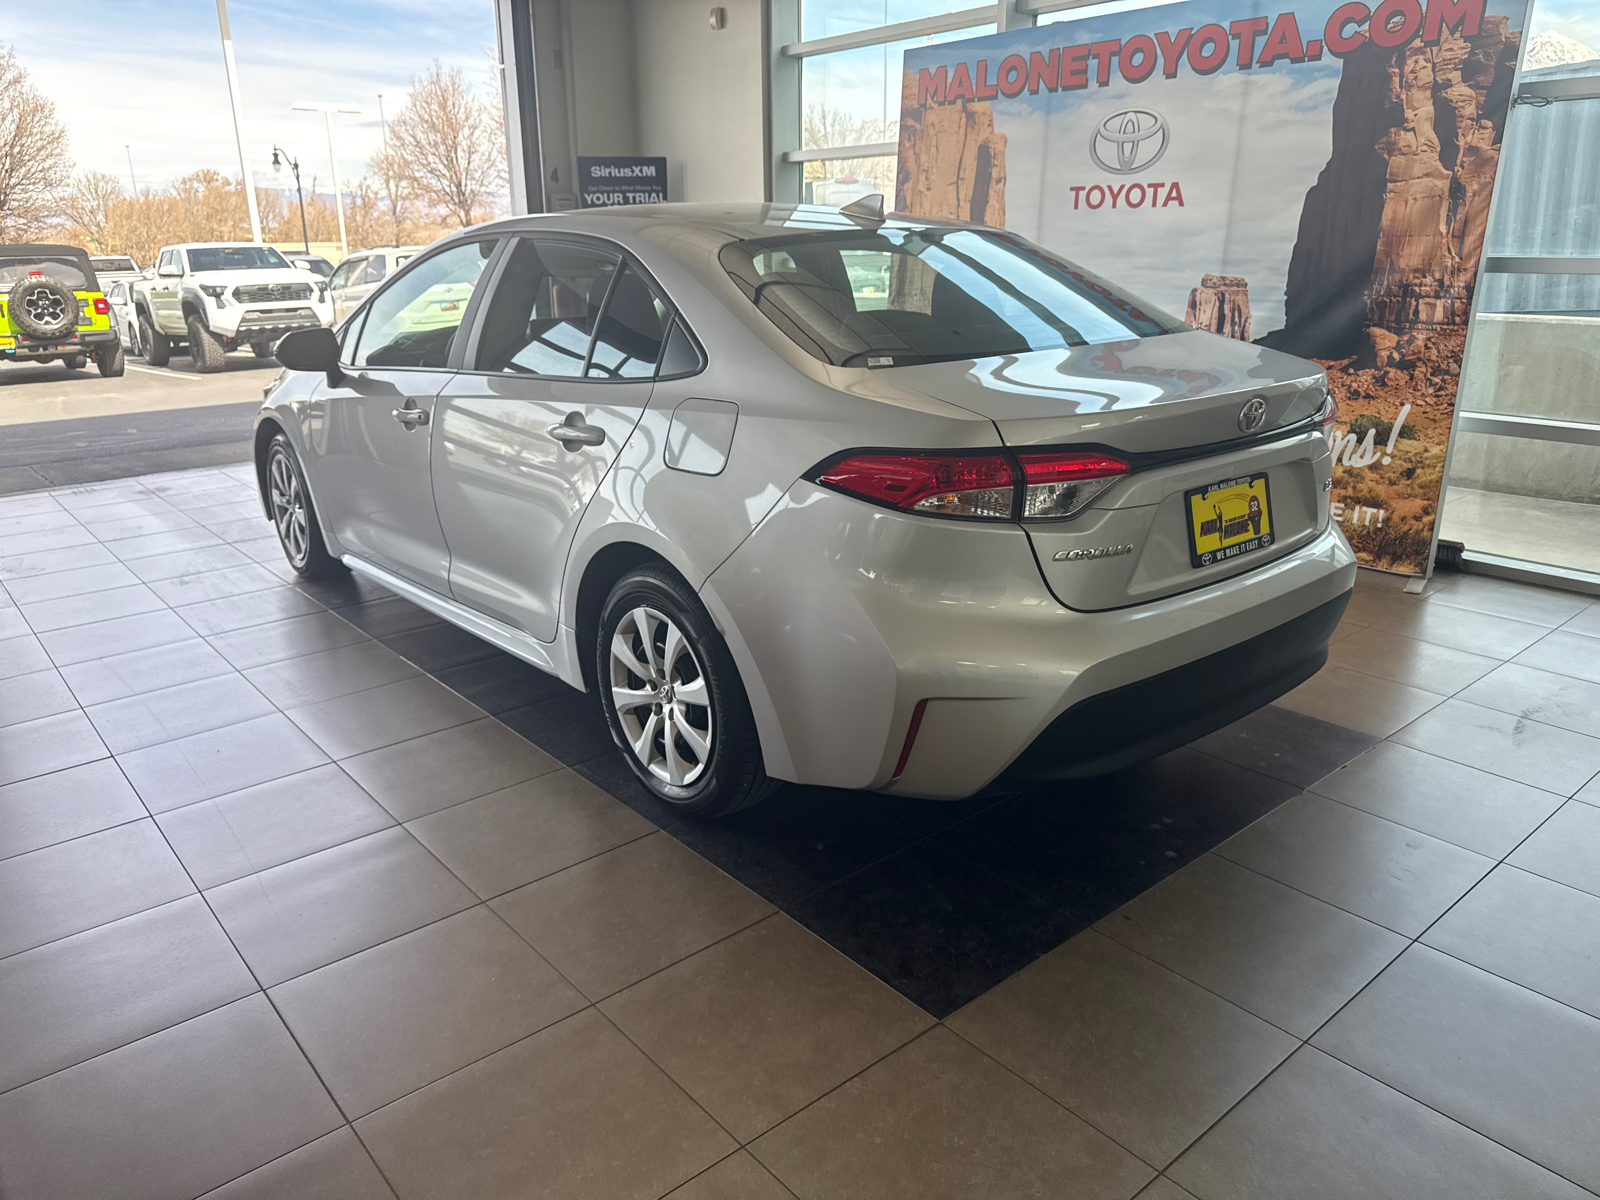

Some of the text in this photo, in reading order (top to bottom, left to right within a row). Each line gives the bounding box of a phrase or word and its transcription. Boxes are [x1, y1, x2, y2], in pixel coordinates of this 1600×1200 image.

[918, 0, 1487, 105] MALONETOYOTA.COM
[590, 165, 656, 178] SiriusXM
[583, 192, 624, 205] YOUR
[625, 192, 667, 204] TRIAL
[1069, 181, 1185, 210] TOYOTA
[1250, 501, 1259, 511] 32
[1352, 505, 1385, 528] IT!
[1052, 544, 1134, 562] COROLLA
[1216, 540, 1258, 560] WE MAKE IT EASY
